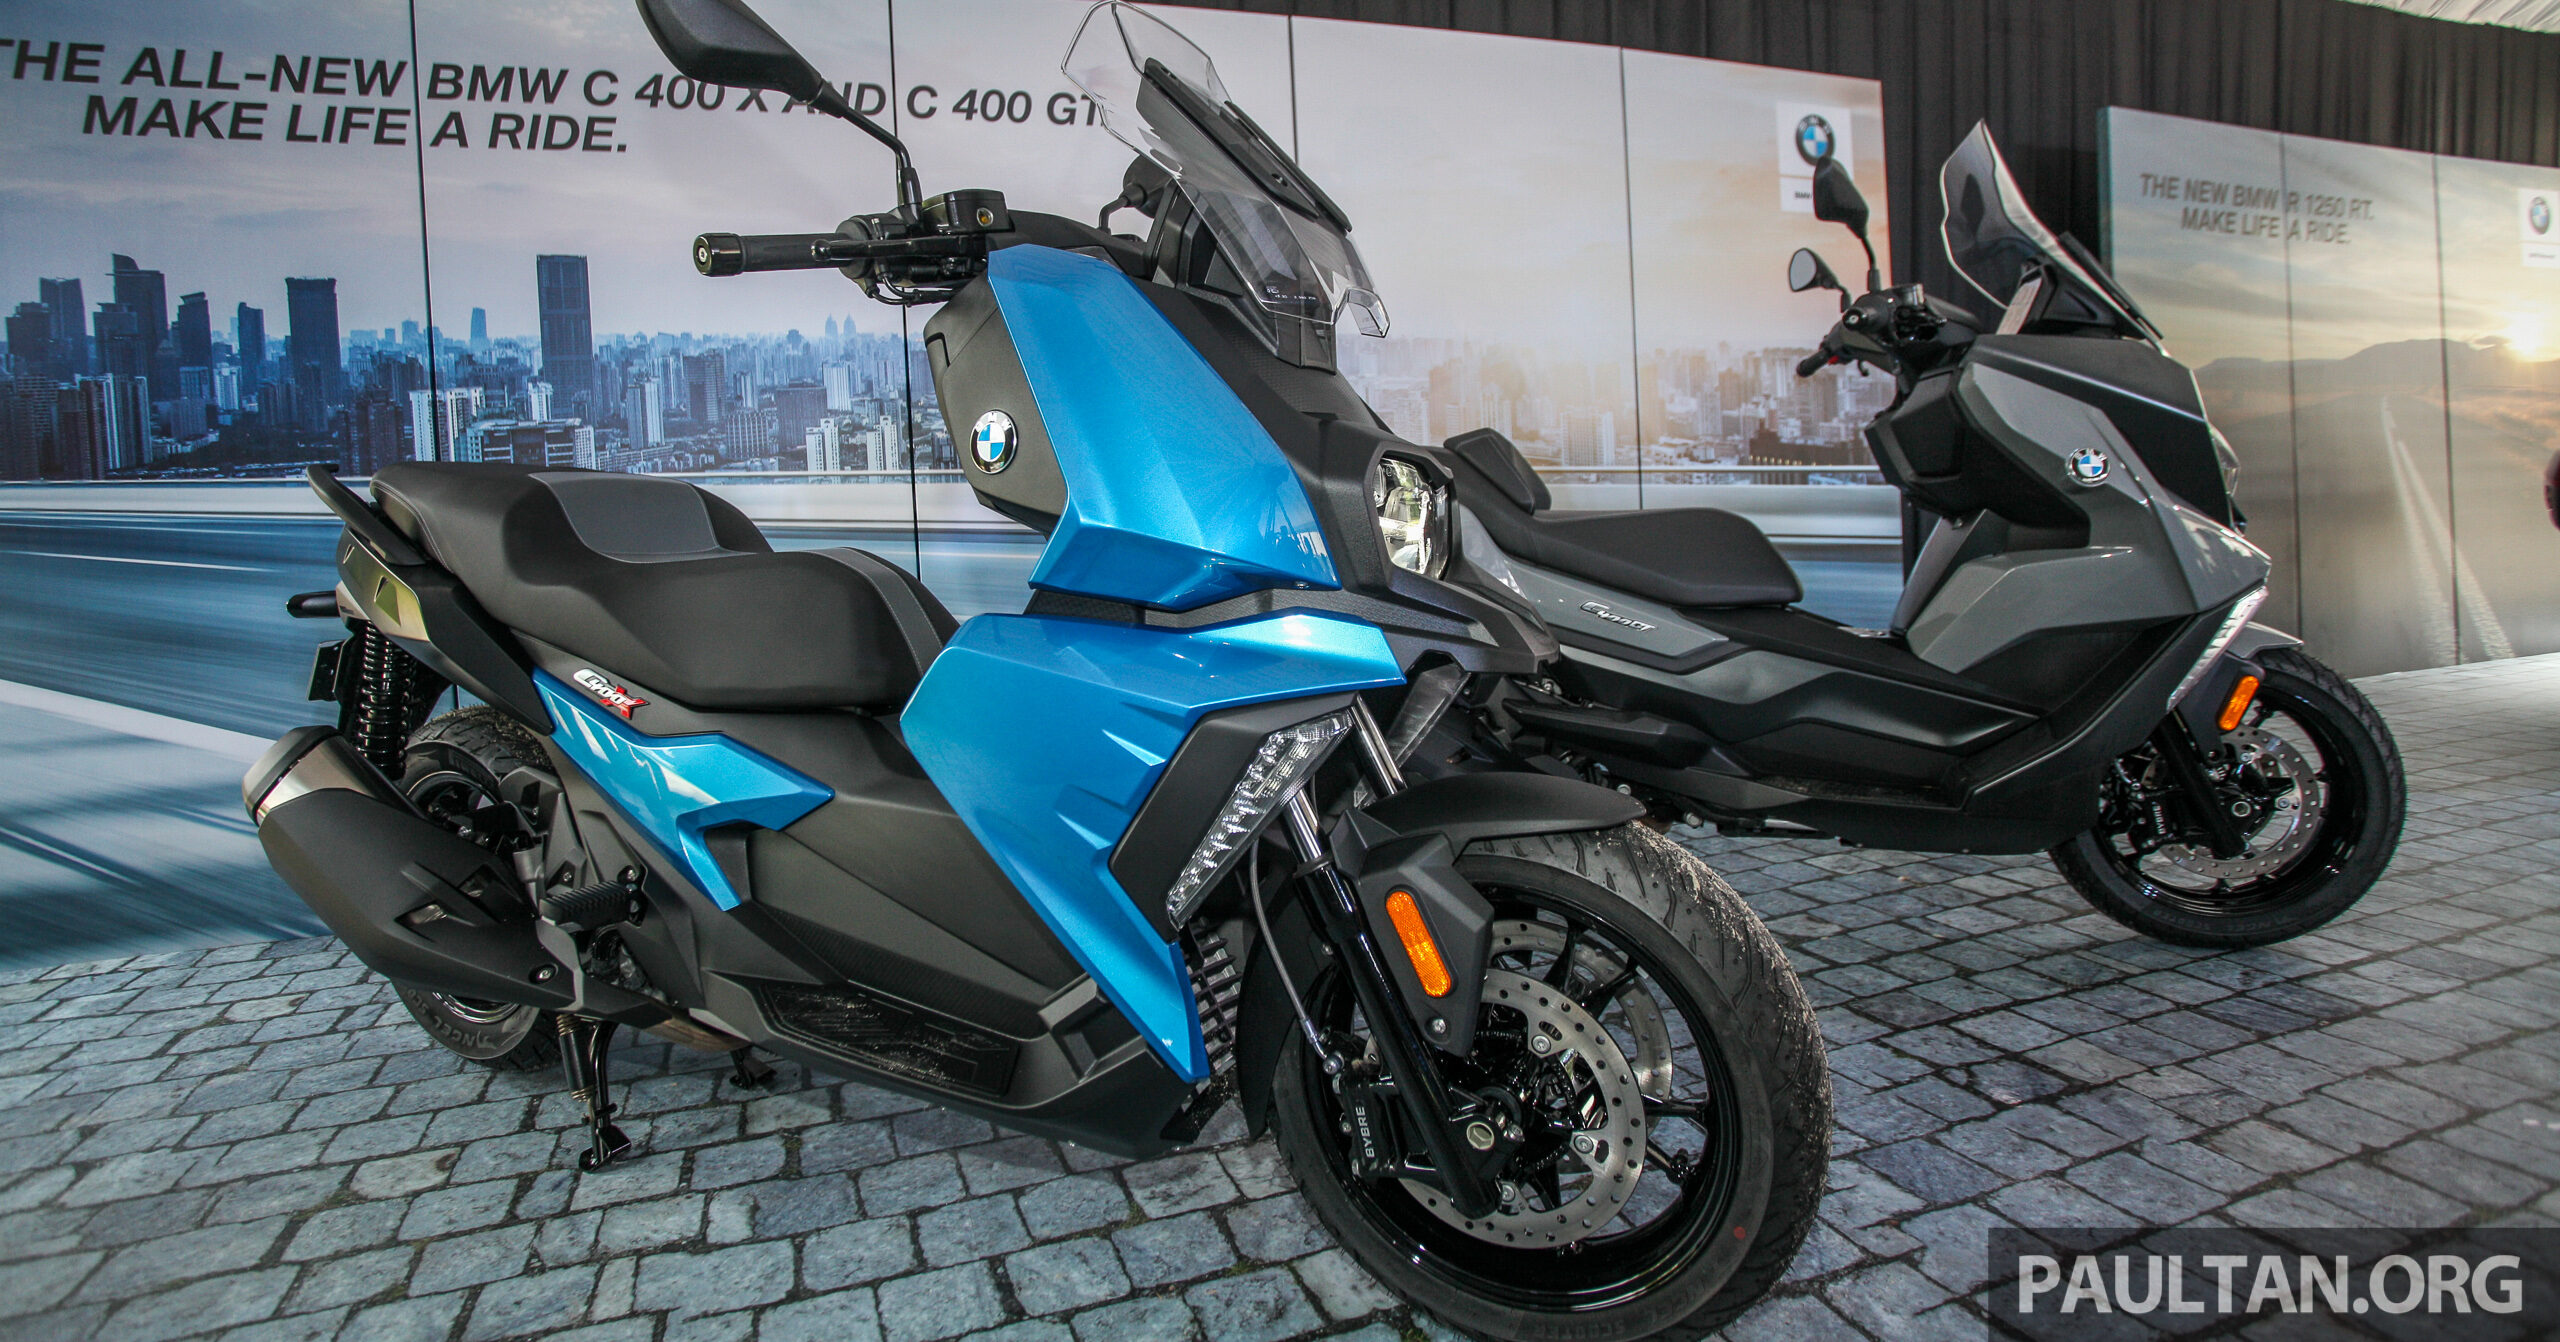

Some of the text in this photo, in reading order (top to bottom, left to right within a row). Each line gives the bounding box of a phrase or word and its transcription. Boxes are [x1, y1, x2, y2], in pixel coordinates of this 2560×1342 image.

[121, 47, 406, 97] ALL-NEW
[427, 63, 568, 104] BMW
[583, 70, 618, 106] C
[635, 73, 726, 111] 400
[906, 85, 938, 119] C
[952, 88, 1032, 123] 400
[83, 95, 627, 152] MAKE LIFE A RIDE.
[2140, 173, 2374, 221] THE NEW BMW R 1250 RT.
[2181, 206, 2350, 244] MAKE LIFE A RIDE.
[1355, 1106, 1375, 1158] BYBRE
